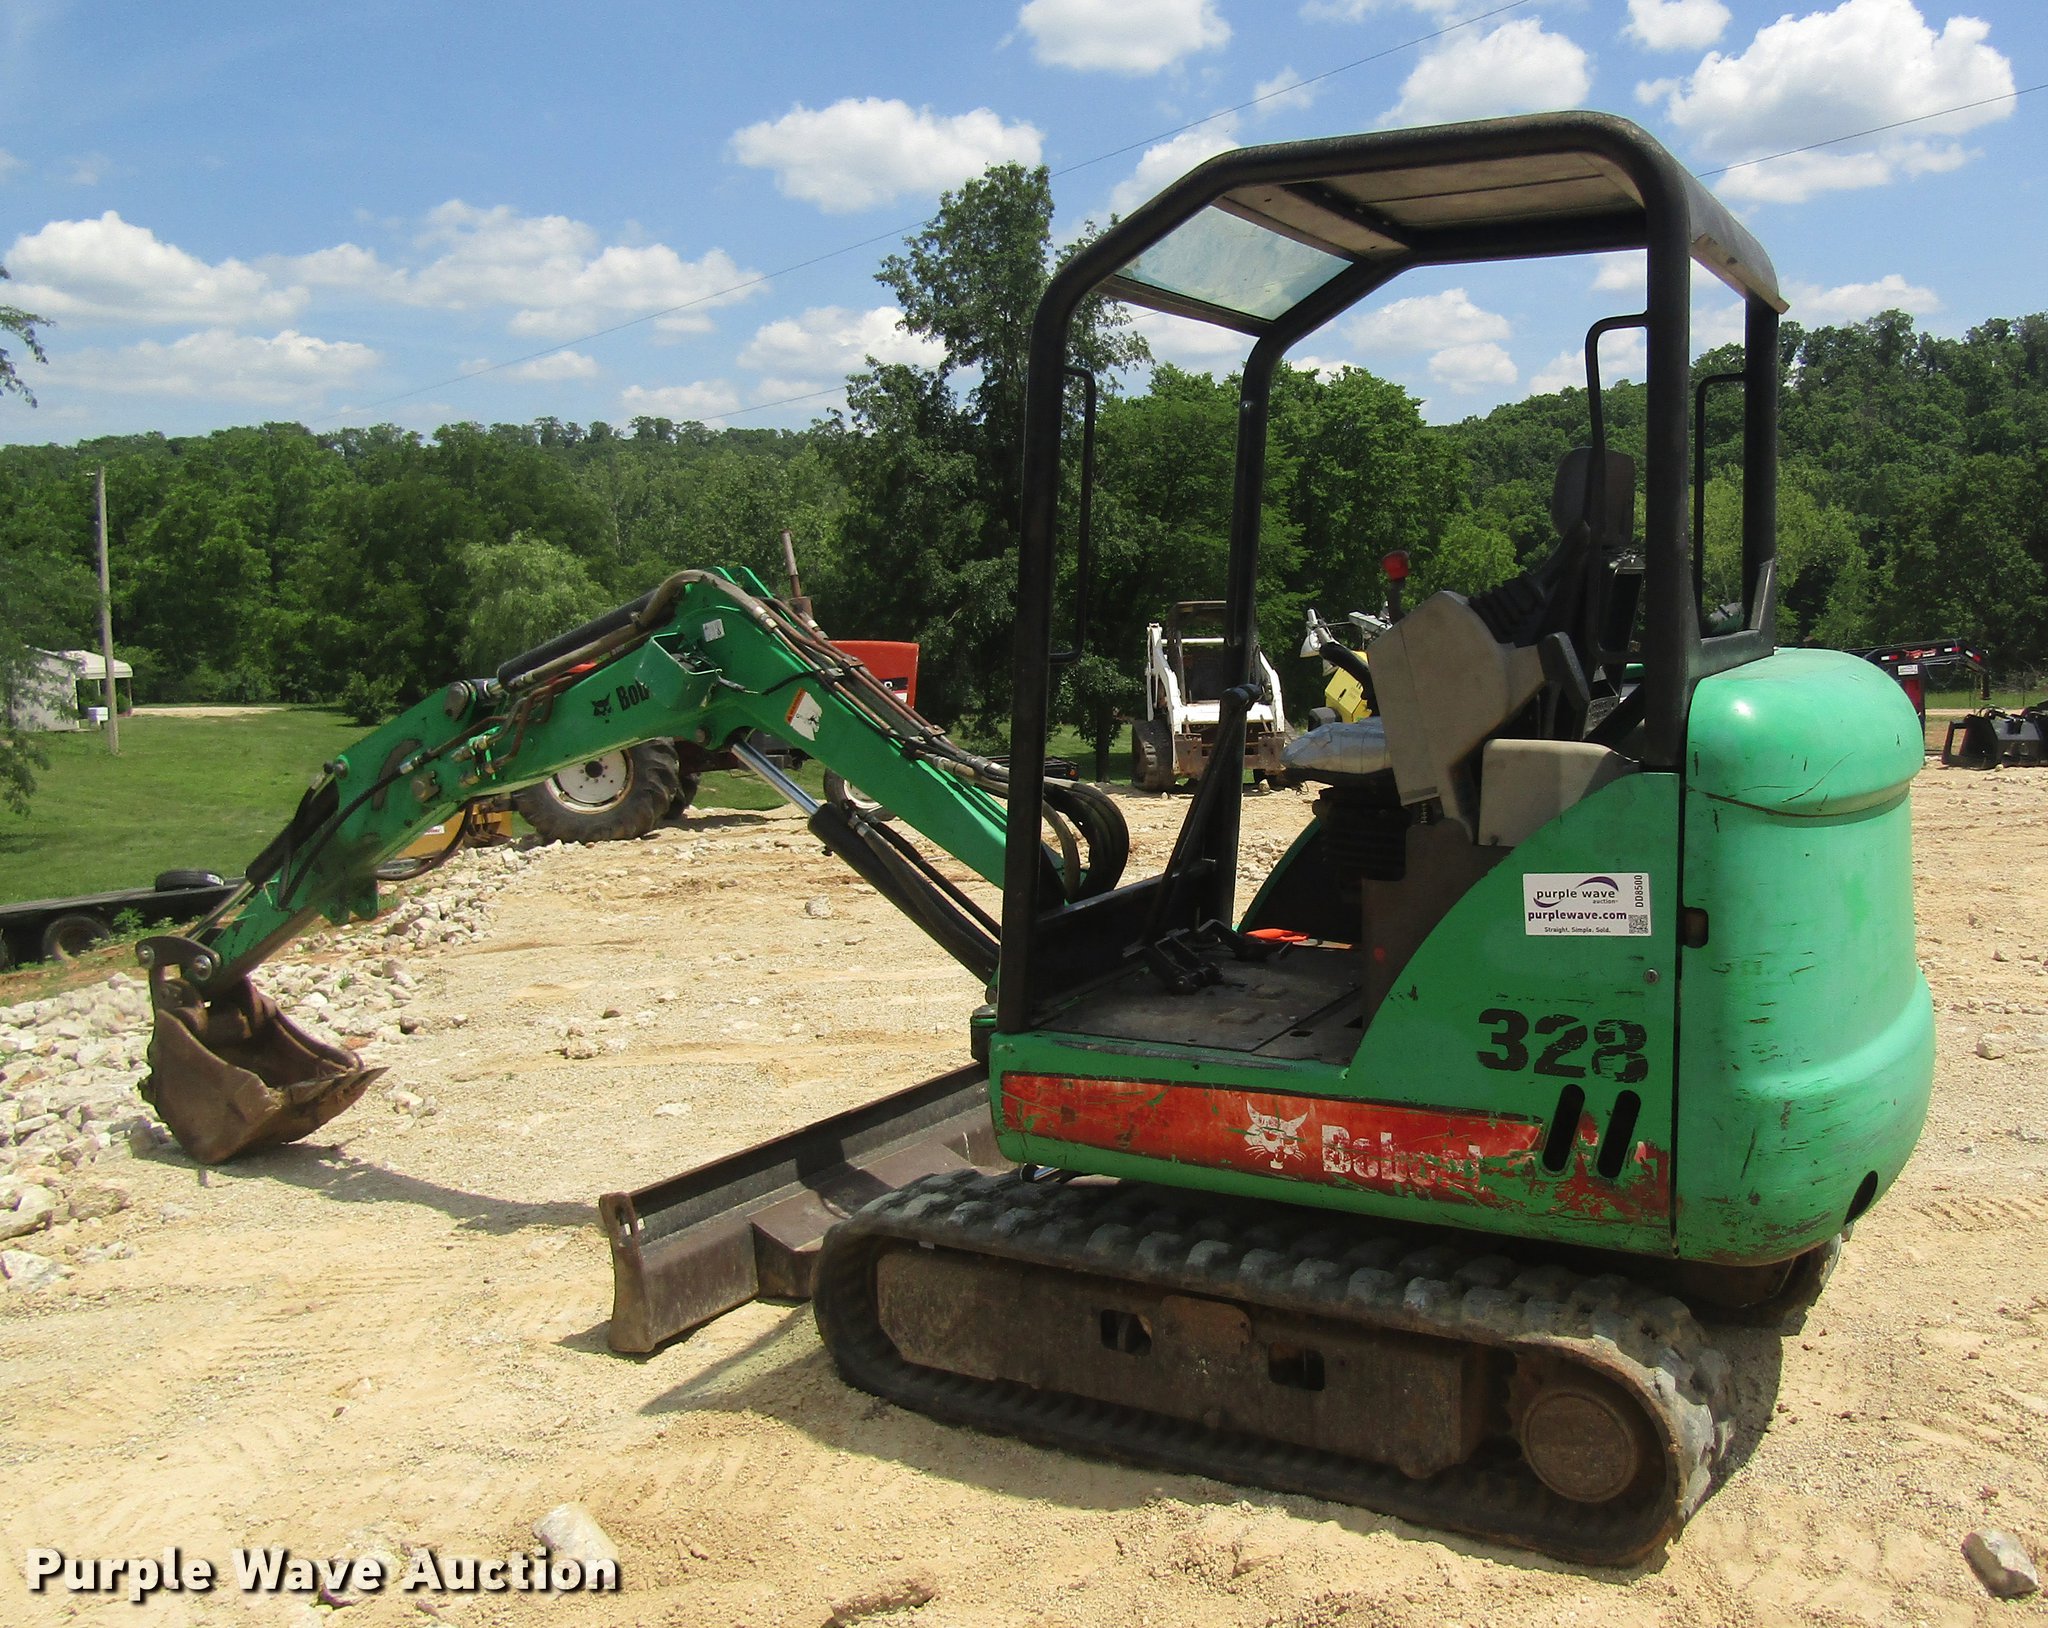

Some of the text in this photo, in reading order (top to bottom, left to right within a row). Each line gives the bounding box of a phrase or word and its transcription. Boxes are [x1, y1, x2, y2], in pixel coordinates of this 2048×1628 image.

[1536, 888, 1616, 900] purple wave
[1634, 875, 1644, 908] DD8500
[1528, 910, 1627, 921] purplewave.com
[1544, 926, 1570, 934] Straight.
[1571, 926, 1594, 934] Simple.
[1476, 1008, 1648, 1083] 328
[1321, 1124, 1483, 1187] Bobc
